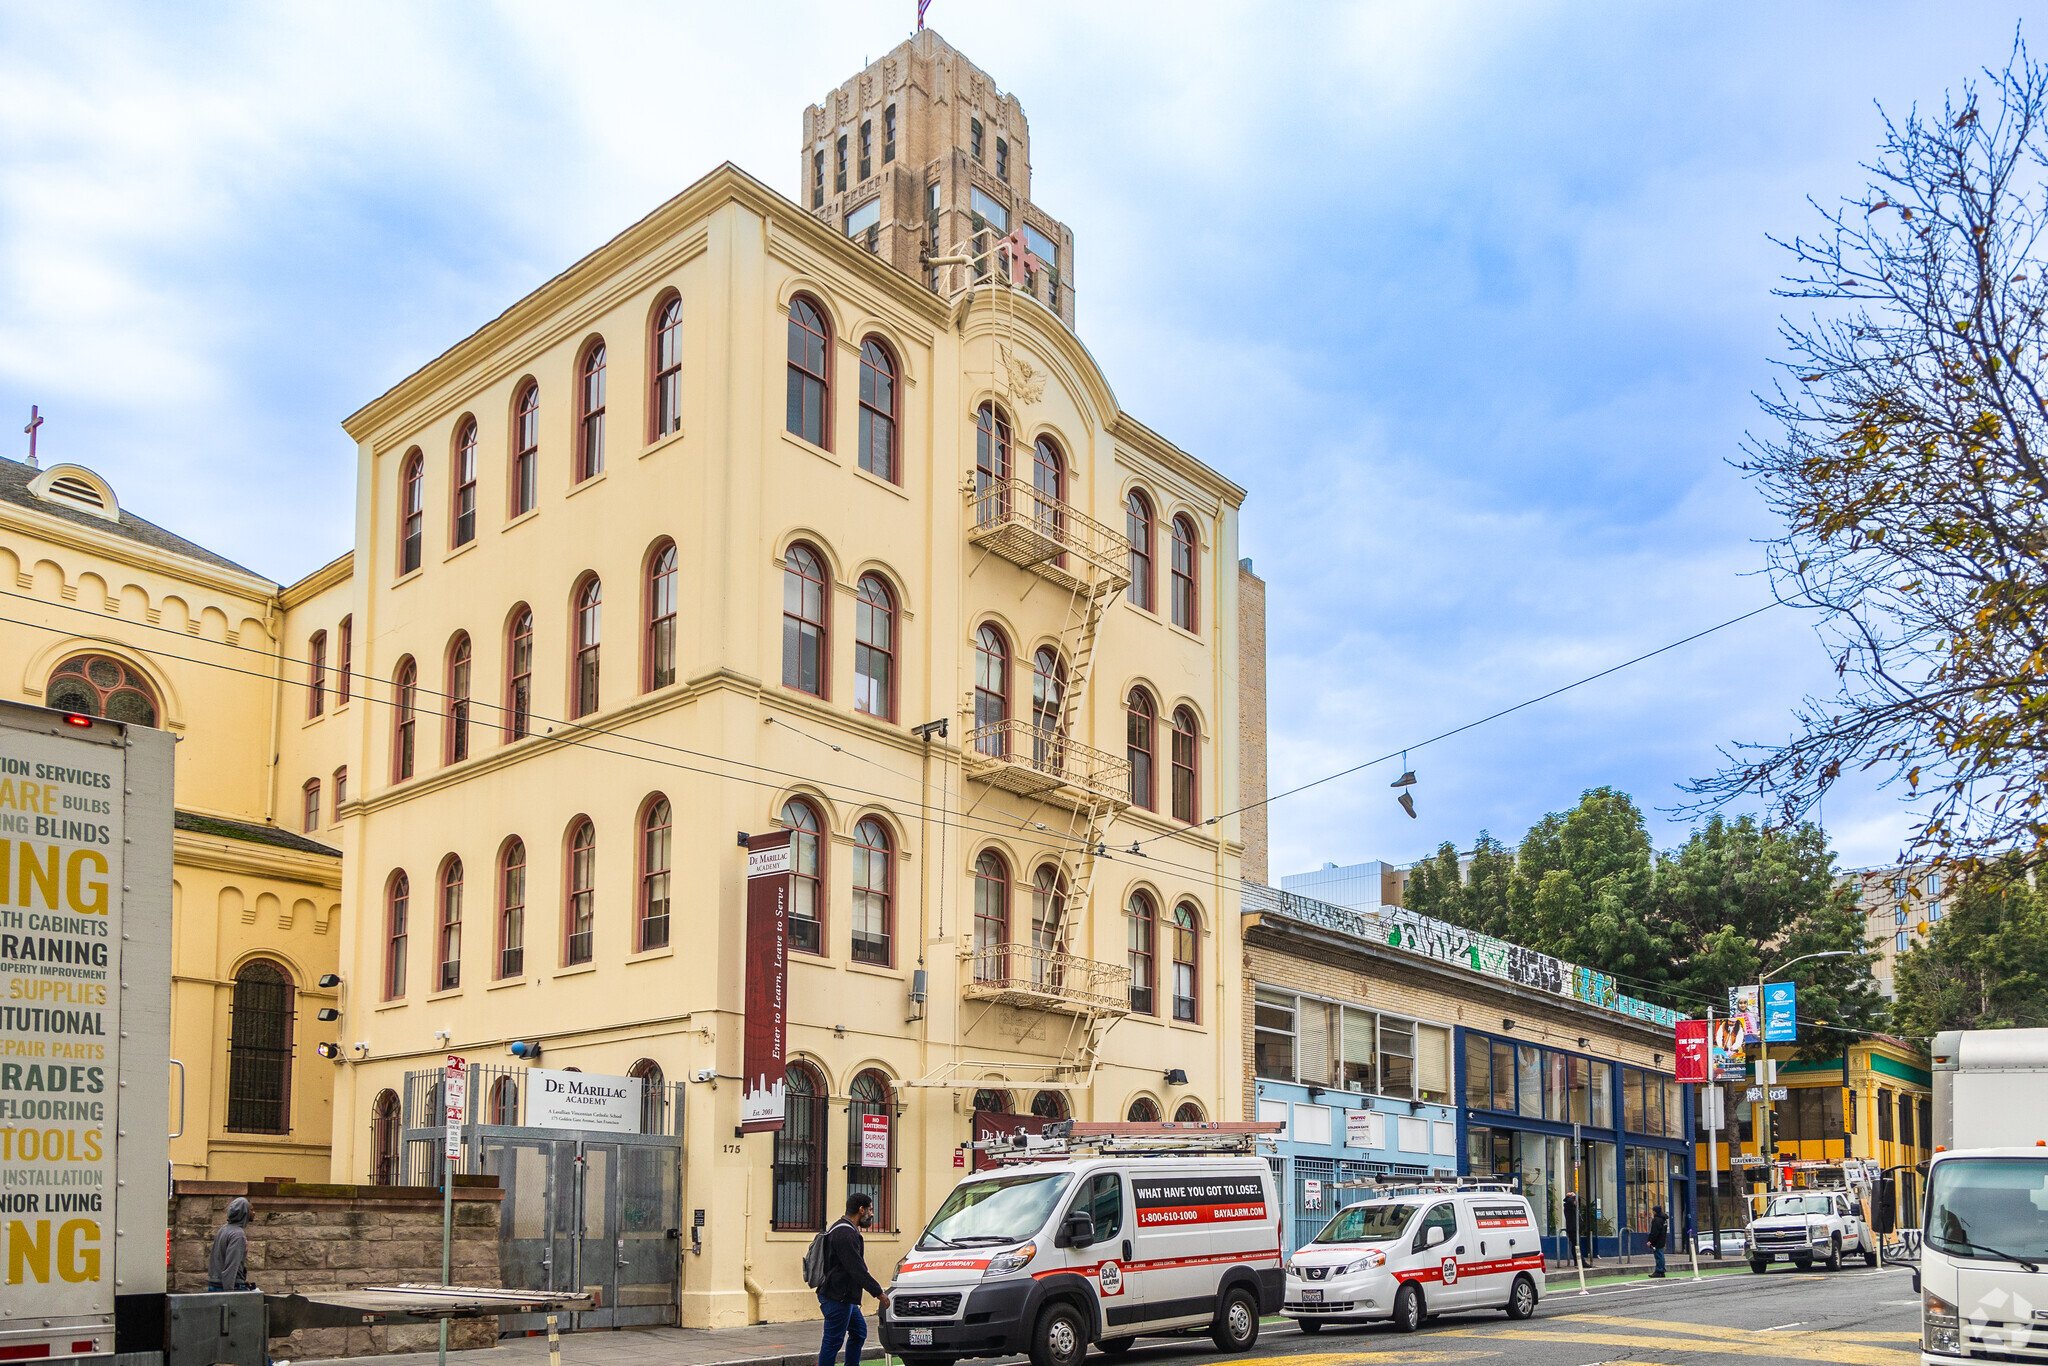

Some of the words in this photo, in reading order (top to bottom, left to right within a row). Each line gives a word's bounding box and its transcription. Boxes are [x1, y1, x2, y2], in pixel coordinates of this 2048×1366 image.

[0, 757, 30, 777] ION
[35, 763, 111, 789] SERVICES
[62, 794, 111, 815] BULBS
[0, 813, 29, 835] NG
[35, 815, 110, 845] BLINDS
[756, 862, 781, 872] ACADEMY
[0, 838, 109, 916] ING
[775, 886, 784, 918] Serve
[0, 910, 23, 928] TH
[28, 914, 108, 937] CABINETS
[776, 920, 783, 932] to
[774, 935, 782, 968] Leave
[40, 966, 107, 980] IMPROVEMENT
[10, 978, 107, 1005] SUPPLIES
[773, 972, 783, 1010] Learn,
[774, 1012, 781, 1024] to
[52, 1042, 105, 1060] PARTS
[772, 1026, 781, 1060] Enter
[568, 1080, 627, 1098] MARILLAC
[565, 1096, 608, 1106] ACADEMY
[0, 1099, 104, 1121] FLOORING
[0, 1128, 103, 1162] TOOLS
[866, 1133, 886, 1141] DURING
[723, 1144, 741, 1154] 175
[864, 1142, 886, 1150] SCHOOL
[3, 1169, 102, 1186] INSTALLATION
[1137, 1187, 1162, 1198] WHAT
[1164, 1187, 1186, 1198] HAVE
[1186, 1186, 1205, 1197] YOU
[1206, 1185, 1222, 1196] GOT
[1224, 1185, 1234, 1195] TO
[45, 1193, 102, 1212] LIVING
[1141, 1210, 1198, 1222] 1-800-610-1000
[1214, 1207, 1264, 1218] BAYALARM.COM
[1102, 1267, 1118, 1280] BAY
[1444, 1263, 1454, 1272] BAY
[1102, 1278, 1120, 1286] ALARM
[908, 1300, 942, 1309] RAM
